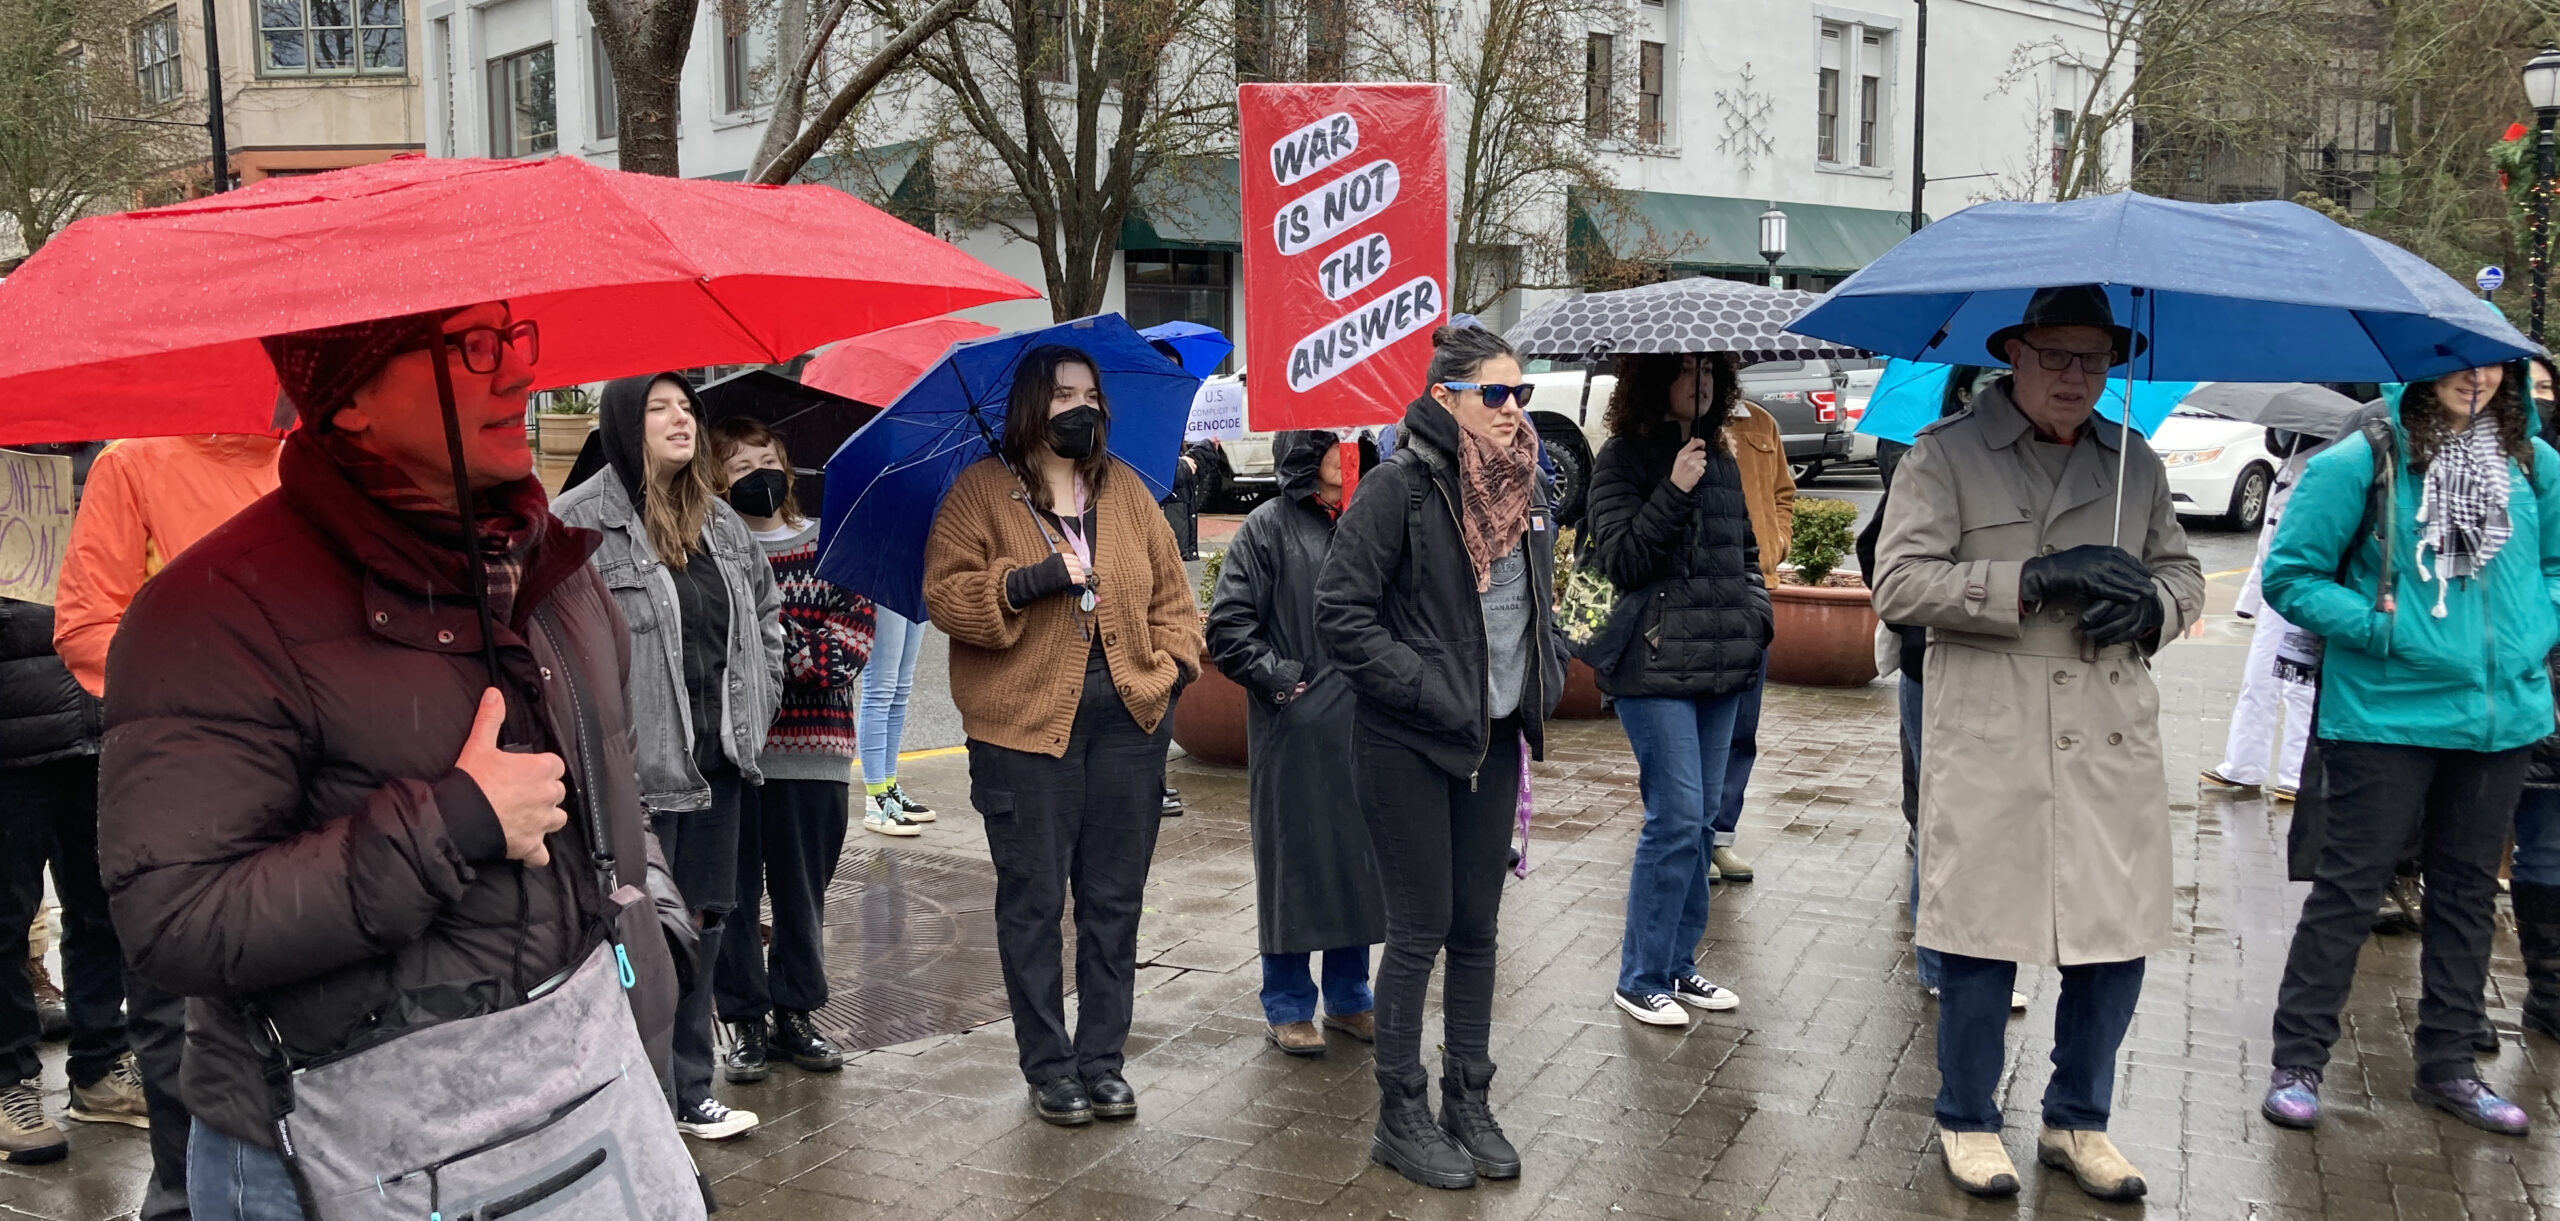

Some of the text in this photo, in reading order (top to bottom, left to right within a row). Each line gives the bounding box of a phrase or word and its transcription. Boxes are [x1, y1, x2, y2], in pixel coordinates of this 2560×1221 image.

[1274, 115, 1352, 183] WAR
[1278, 162, 1391, 253] IS NOT
[1319, 234, 1385, 299] THE
[1291, 281, 1435, 387] ANSWER
[1188, 418, 1240, 431] GENOCIDE
[1191, 406, 1228, 417] COMPLICIT
[1205, 390, 1226, 403] U.S.
[0, 514, 56, 589] ON
[1490, 603, 1519, 611] CANADA
